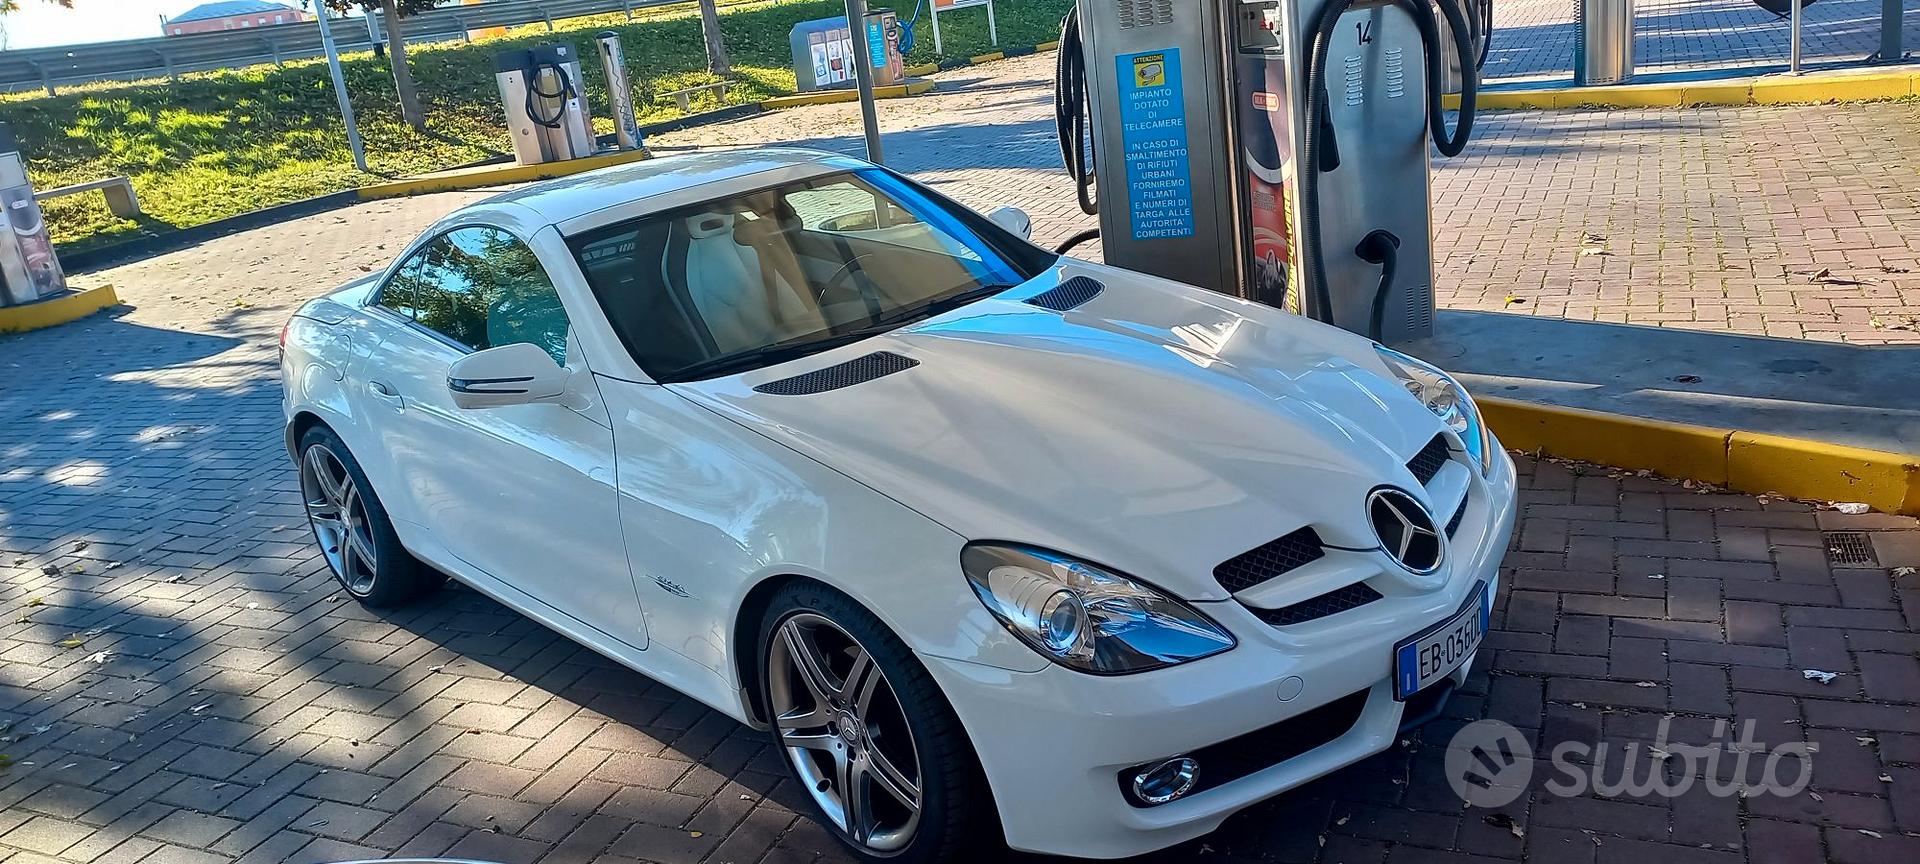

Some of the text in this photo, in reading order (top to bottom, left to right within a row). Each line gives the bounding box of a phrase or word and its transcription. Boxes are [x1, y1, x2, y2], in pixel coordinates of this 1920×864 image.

[1355, 20, 1373, 45] 14
[1133, 54, 1164, 64] ATTENZIONE
[1129, 88, 1172, 101] IMPIANTO
[1134, 99, 1169, 110] DOTATO
[1148, 111, 1157, 119] DI
[1124, 118, 1184, 131] TELECAMERE
[1132, 139, 1179, 151] IN CASO DI
[1126, 148, 1188, 161] SMALTIMENTO
[1137, 160, 1178, 170] DI RIFIUTI
[1141, 170, 1175, 180] URBANI
[1133, 179, 1185, 190] FORNIREMO
[1143, 189, 1177, 200] FILMATI
[1135, 198, 1187, 210] E NUMERI DI
[1135, 208, 1191, 219] TARGA ALLE
[1136, 228, 1191, 238] COMPETENTI
